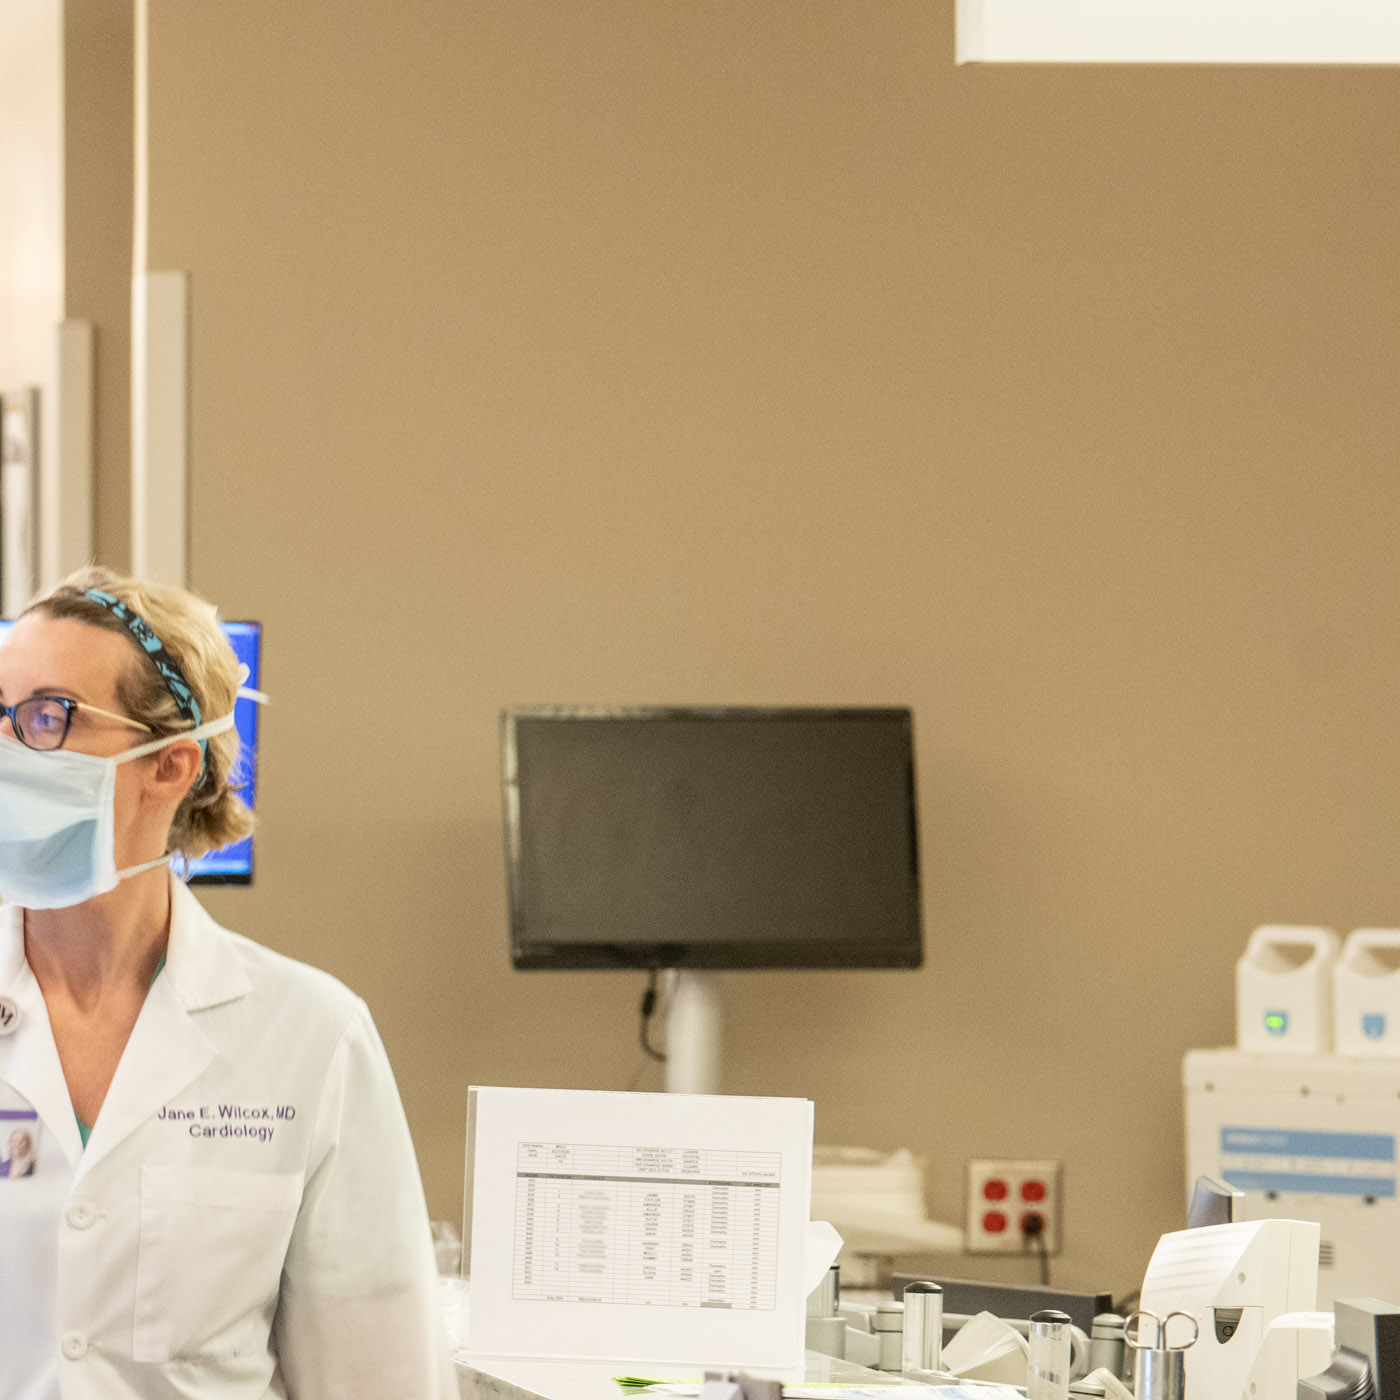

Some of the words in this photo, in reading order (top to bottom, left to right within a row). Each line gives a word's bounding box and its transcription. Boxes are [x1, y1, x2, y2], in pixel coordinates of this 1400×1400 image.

[158, 1106, 195, 1120] Jane
[199, 1106, 215, 1119] E.
[189, 1123, 274, 1142] Cardiology
